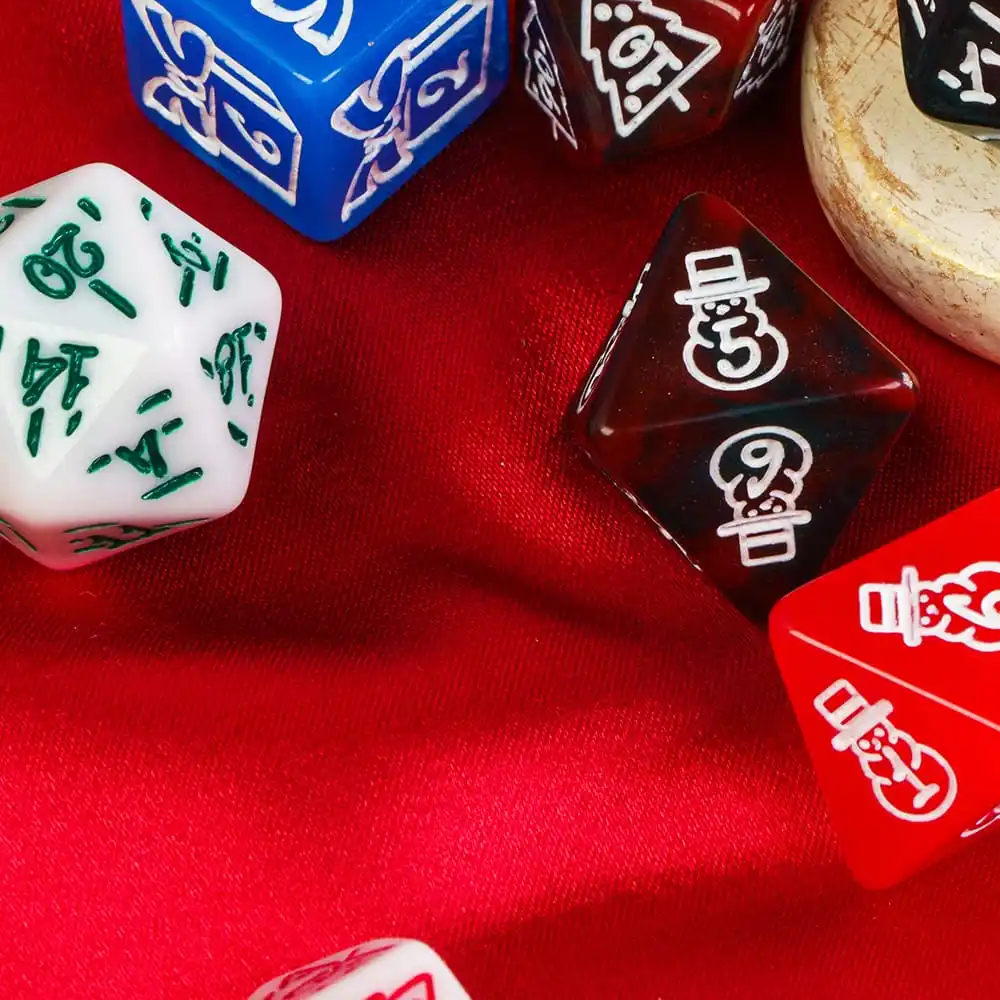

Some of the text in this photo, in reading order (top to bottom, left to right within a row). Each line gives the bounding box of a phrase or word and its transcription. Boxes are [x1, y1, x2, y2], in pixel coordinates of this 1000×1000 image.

[417, 49, 470, 107] 2
[608, 24, 684, 93] 10
[223, 99, 283, 167] 6
[22, 222, 105, 300] 20
[21, 337, 99, 412] 14
[711, 315, 763, 379] 5
[882, 744, 941, 809] 1
